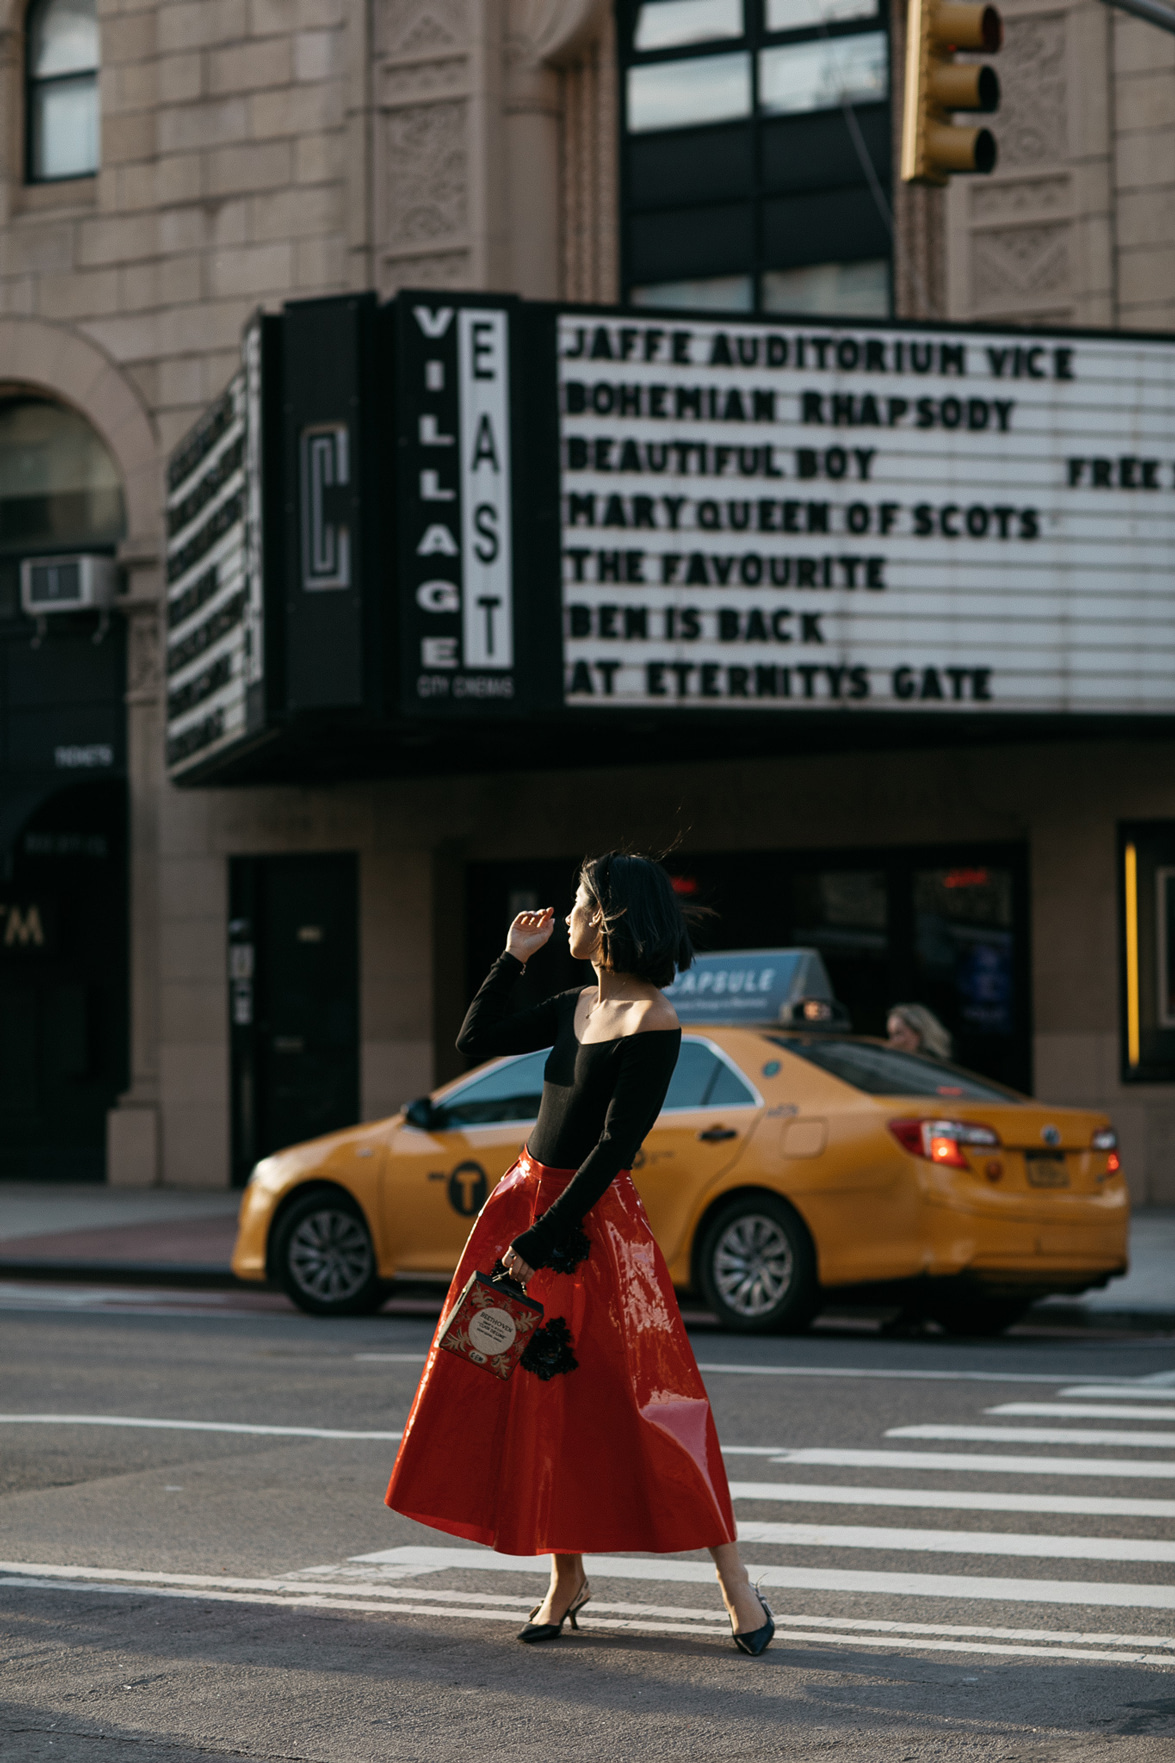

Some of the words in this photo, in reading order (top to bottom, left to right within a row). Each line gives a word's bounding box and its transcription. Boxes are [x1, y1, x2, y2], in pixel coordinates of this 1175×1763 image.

[563, 325, 692, 366] JAFFE
[708, 332, 967, 377] AUDITORIUM
[985, 346, 1075, 382] VICE
[564, 381, 777, 423] BOHEMIAN
[800, 390, 1015, 433] RHAPSODY
[566, 436, 784, 479] BEAUTIFUL
[794, 445, 876, 482] BOY
[1067, 456, 1160, 491] FREE
[414, 306, 459, 668] VILLAGE
[469, 320, 503, 658] EAST
[567, 492, 687, 531] MARY
[696, 498, 831, 535] QUEEN
[845, 502, 900, 536] OF
[912, 503, 1039, 541] SCOTS
[564, 547, 646, 585] THE
[660, 551, 886, 591] FAVOURITE
[568, 603, 650, 641] BEN
[664, 606, 702, 642] IS
[716, 608, 824, 645] BACK
[568, 659, 623, 697] AT
[891, 665, 993, 703] GATE
[480, 1311, 513, 1333] BEETHOVEN
